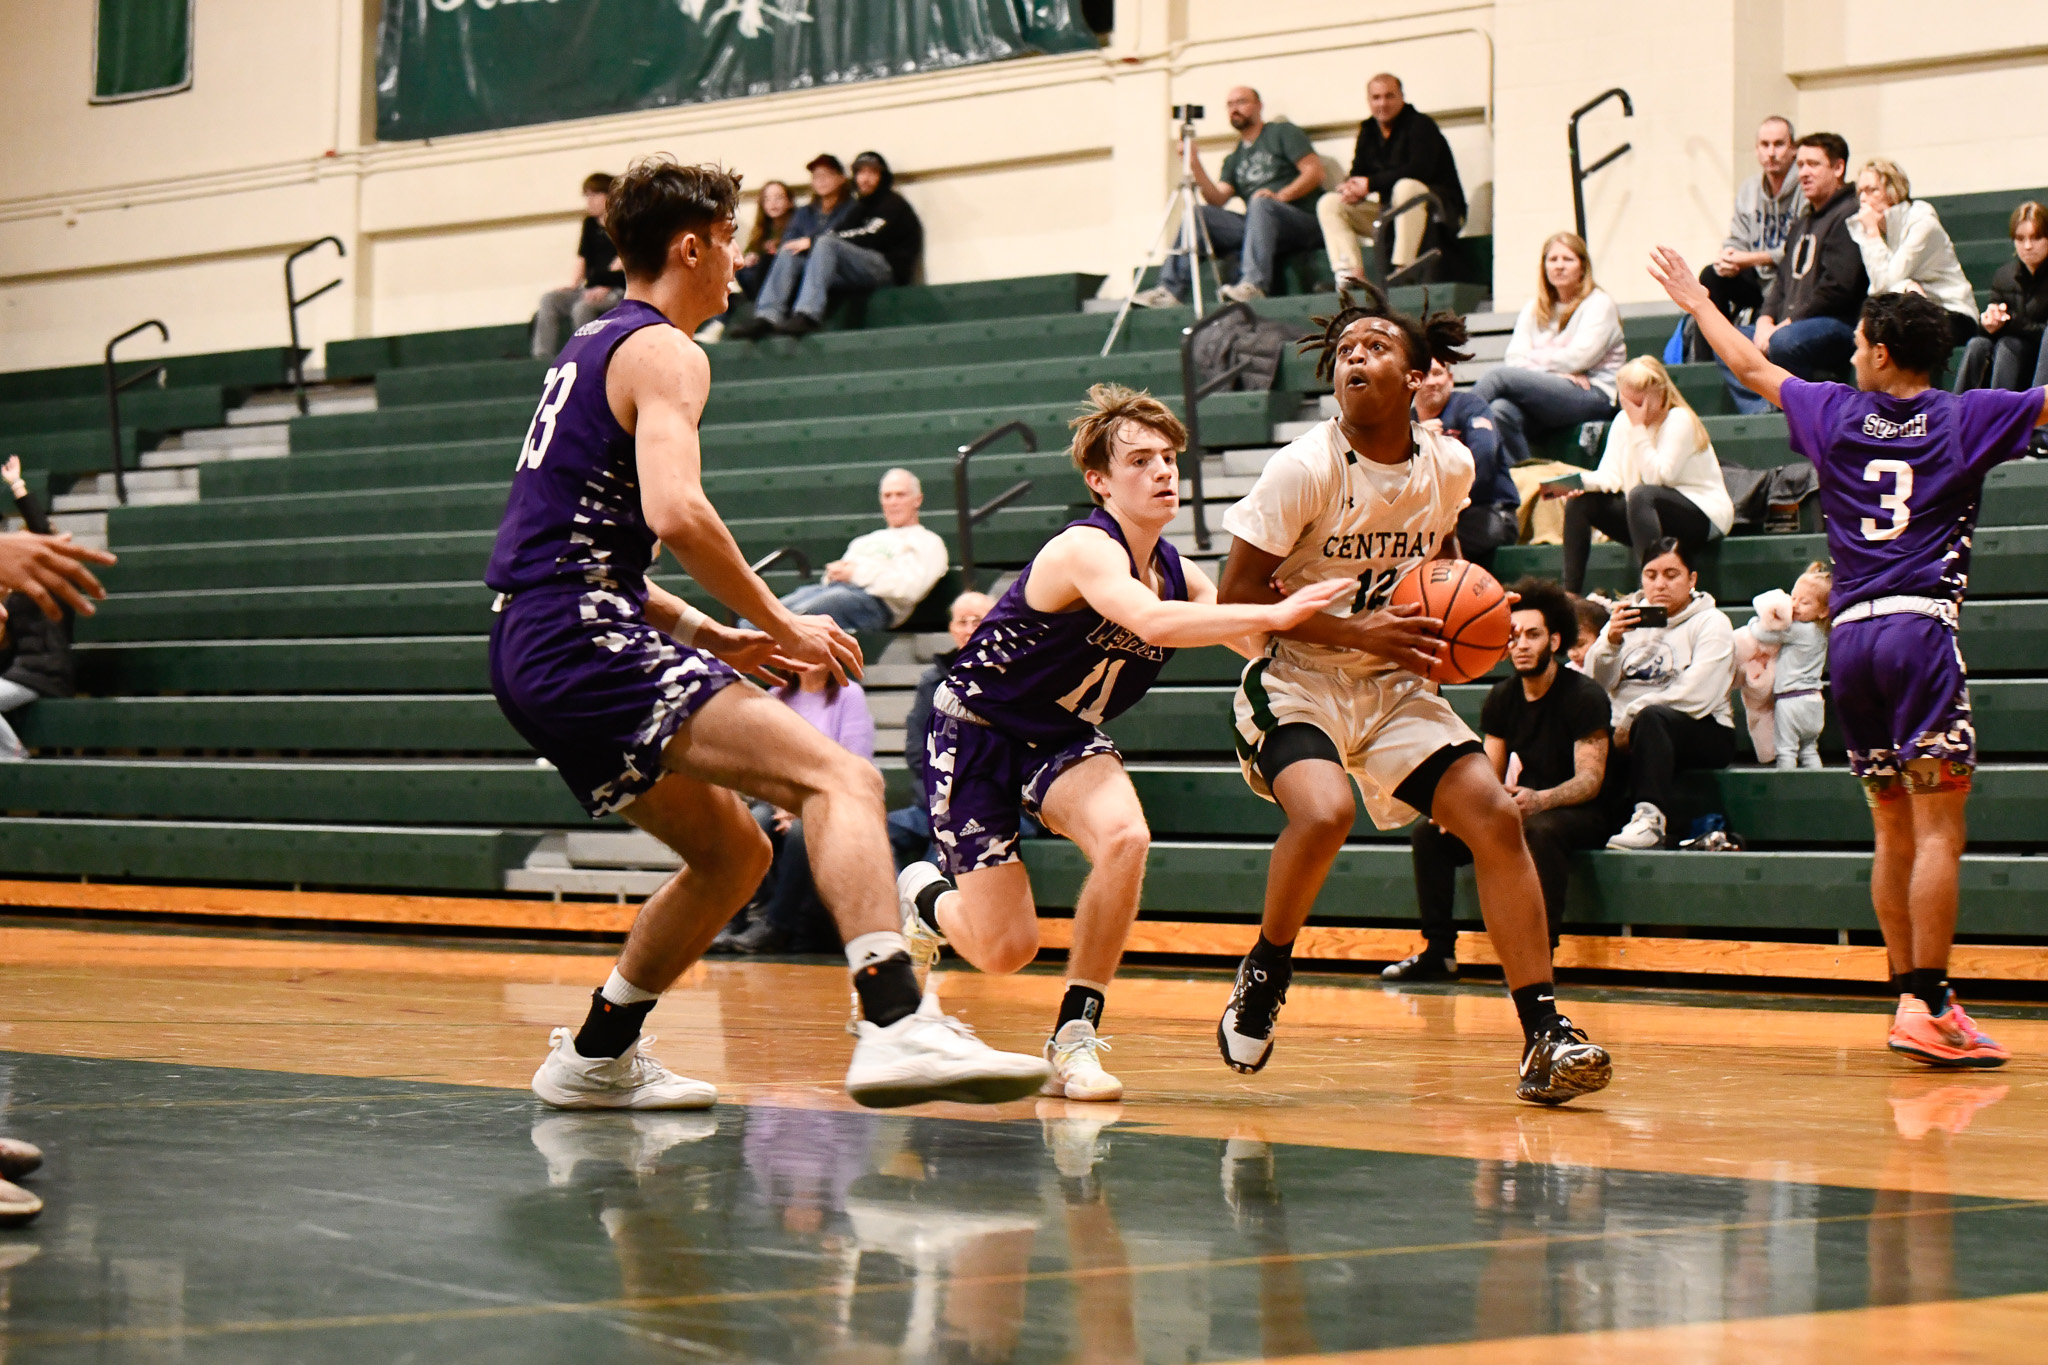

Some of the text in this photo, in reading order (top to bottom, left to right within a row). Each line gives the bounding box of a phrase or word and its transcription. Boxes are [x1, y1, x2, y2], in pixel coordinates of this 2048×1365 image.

[1859, 458, 1914, 541] 3
[1350, 568, 1398, 614] 12
[1054, 657, 1127, 726] 11
